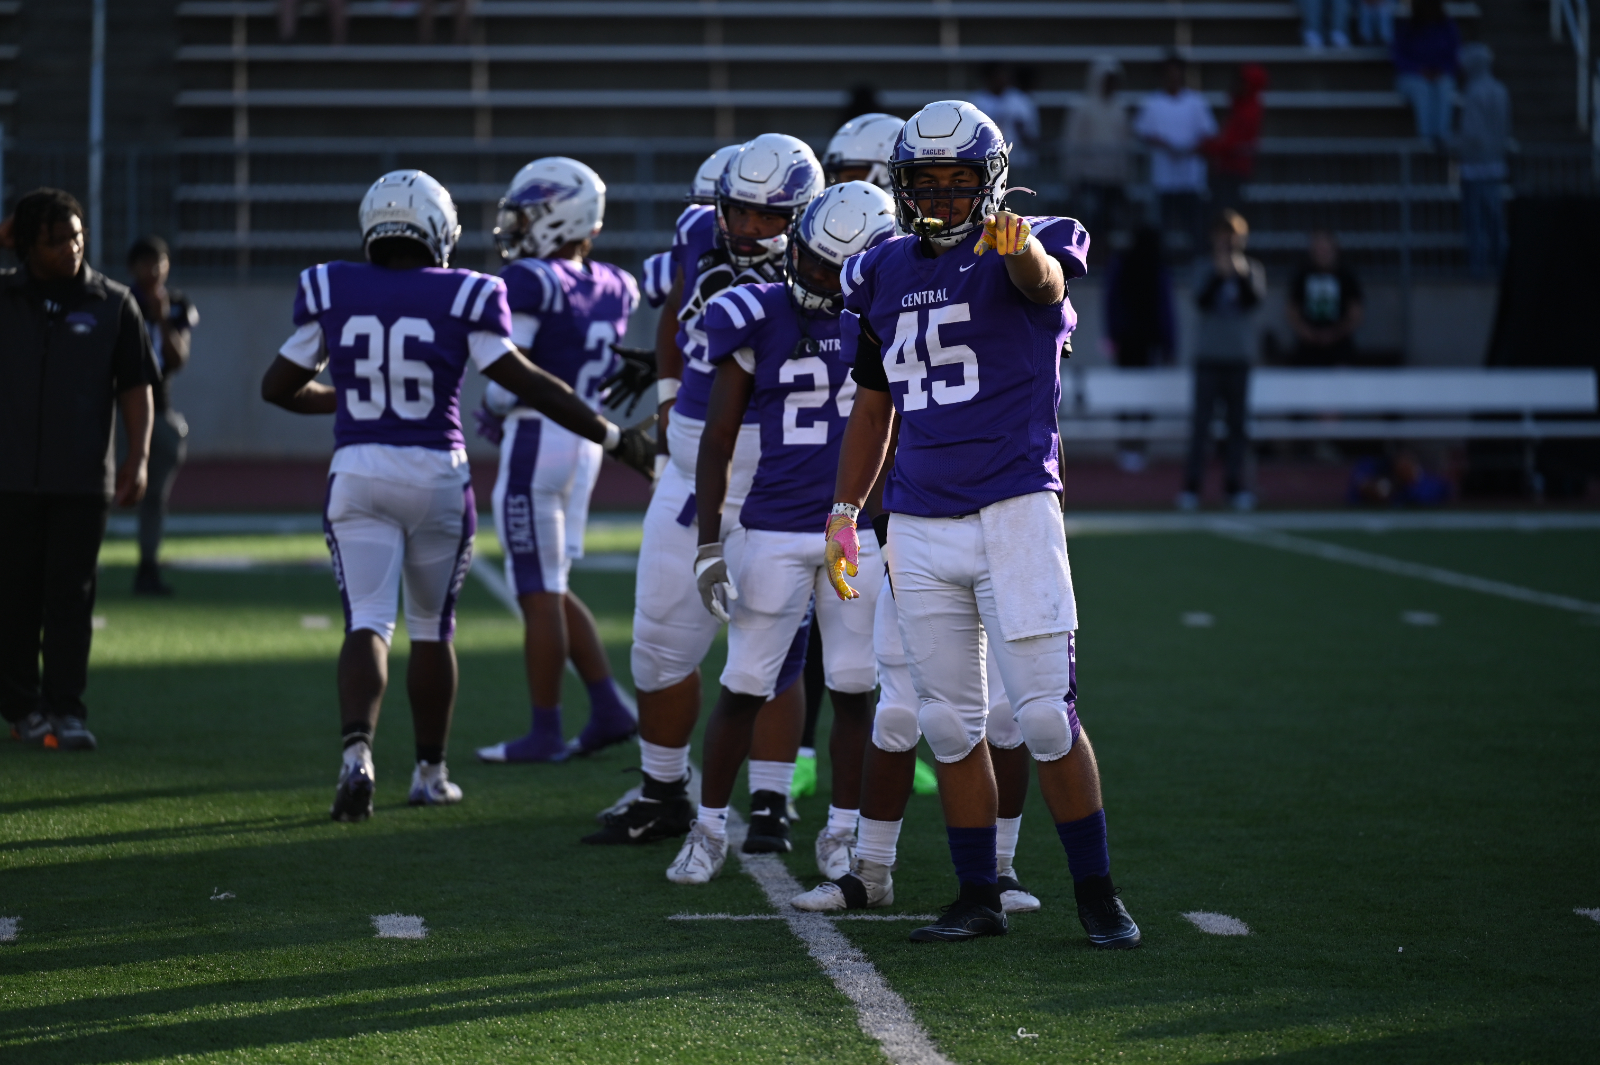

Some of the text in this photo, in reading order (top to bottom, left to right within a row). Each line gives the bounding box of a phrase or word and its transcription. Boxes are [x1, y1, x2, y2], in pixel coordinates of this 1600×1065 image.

[921, 148, 946, 156] EAGLES
[817, 243, 839, 258] EAGLES
[901, 287, 949, 308] CENTRAL
[339, 314, 435, 420] 36
[882, 302, 980, 412] 45
